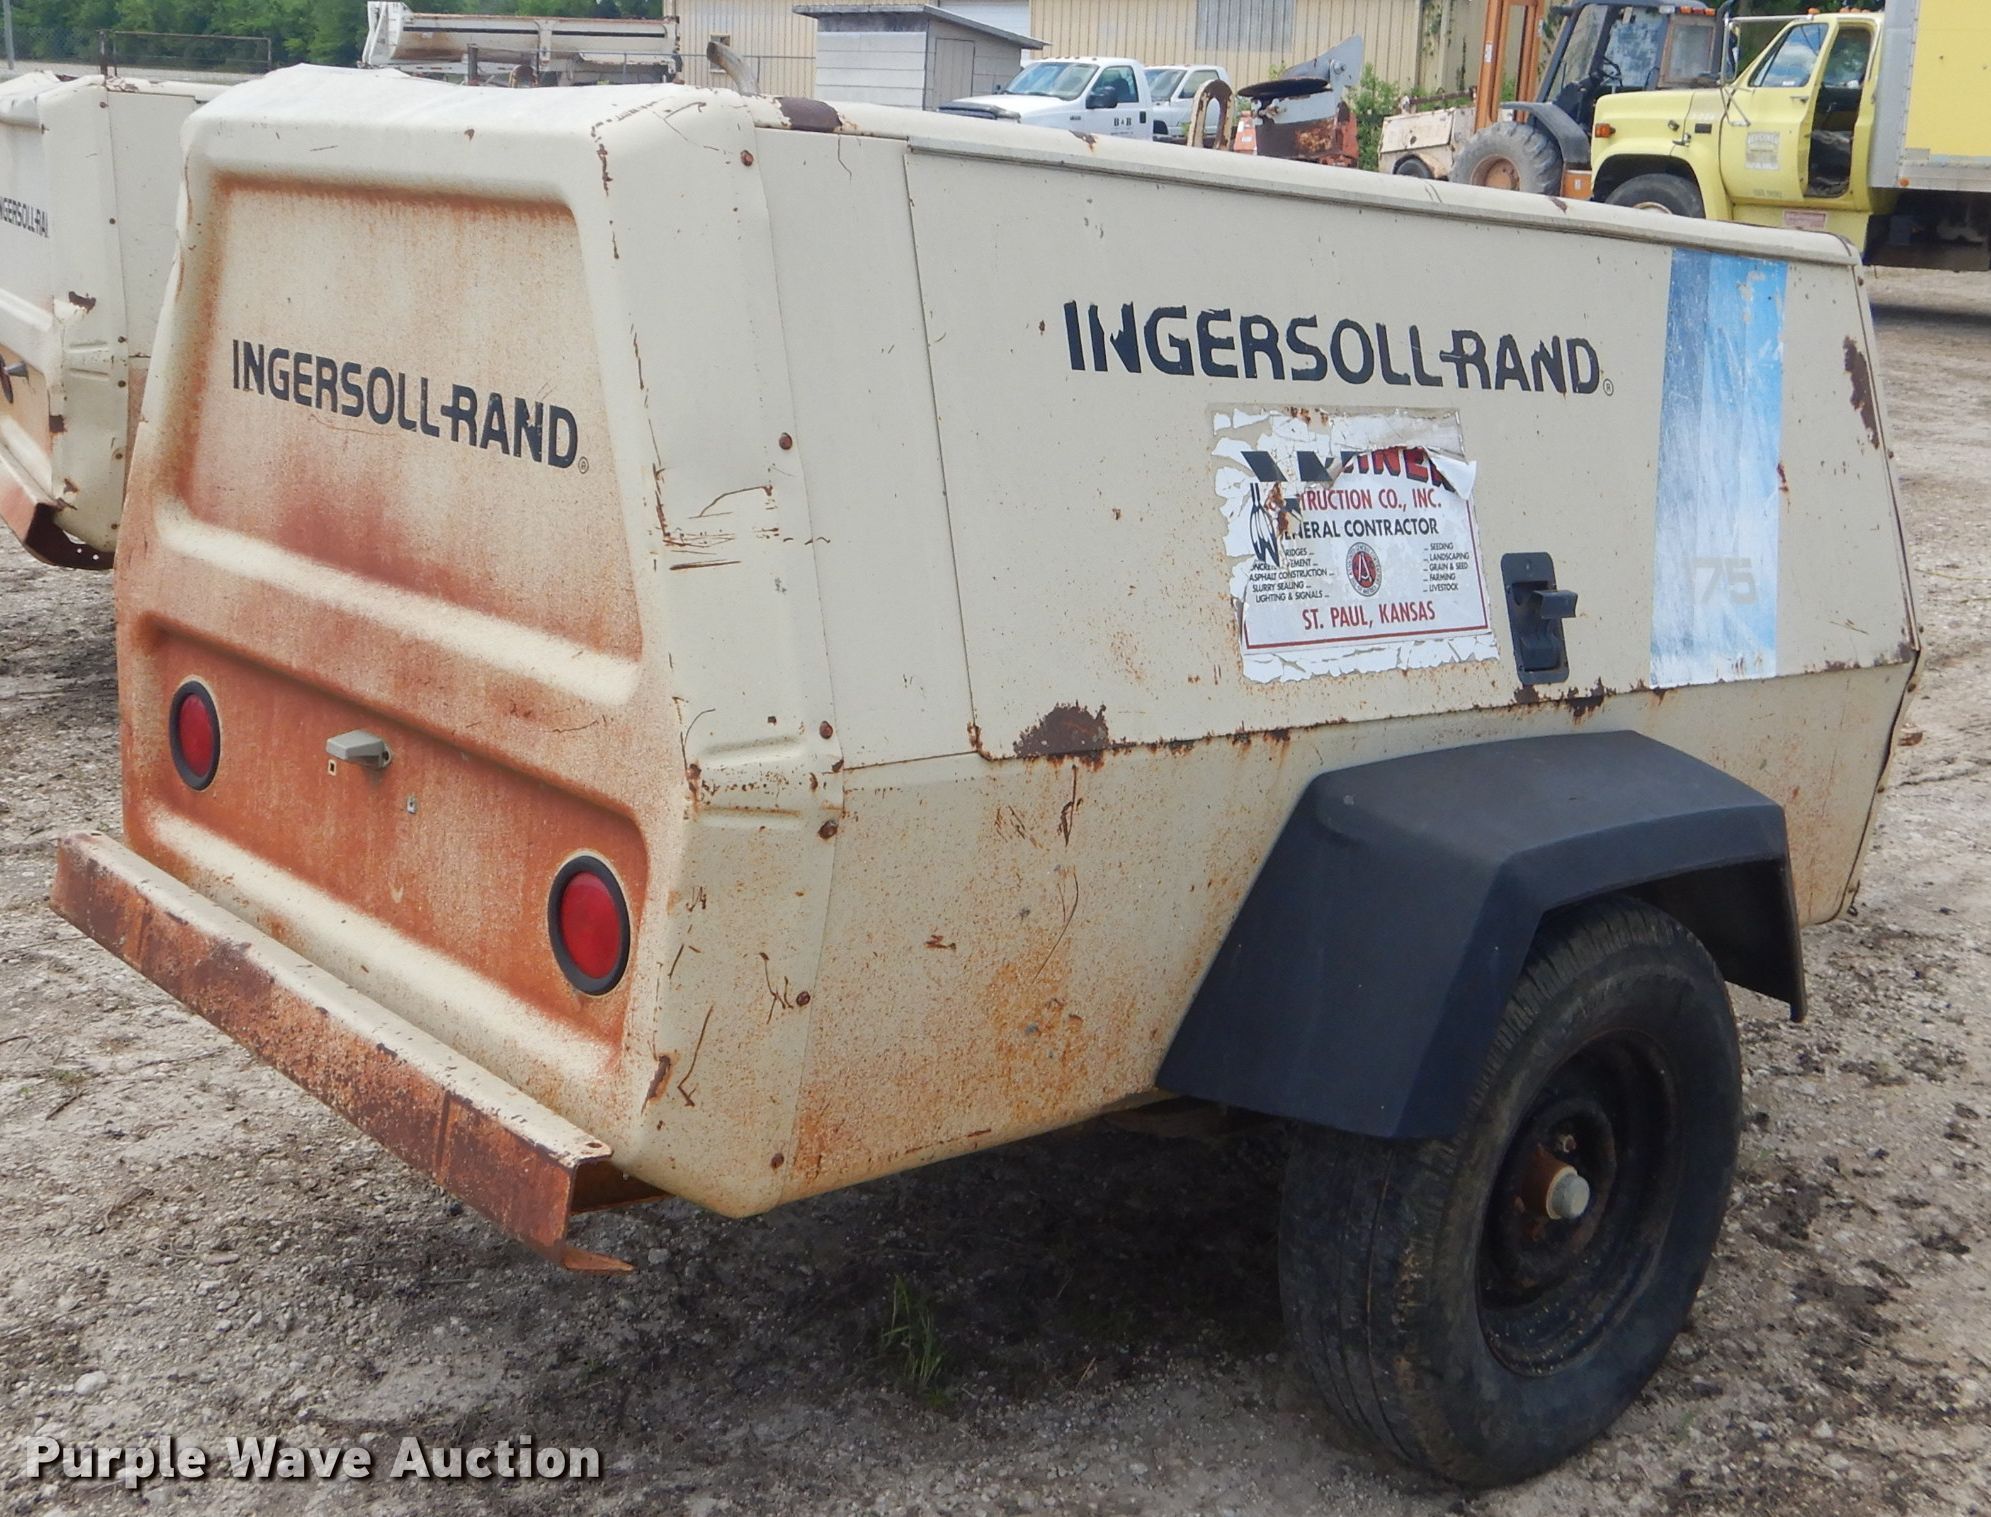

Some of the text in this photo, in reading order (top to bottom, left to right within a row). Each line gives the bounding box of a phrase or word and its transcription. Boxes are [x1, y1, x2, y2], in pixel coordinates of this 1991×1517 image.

[1063, 300, 1600, 395] INGERSOLL-RAND
[232, 339, 579, 469] INGERSOLL-RAND
[1411, 487, 1442, 509] INC.
[1344, 517, 1440, 538] CONTRACTOR
[1430, 542, 1454, 550] SEEDING
[1289, 558, 1311, 567] EMENT
[1429, 552, 1470, 561] LANDSCAPING
[1429, 563, 1449, 571] GRAIN
[1455, 562, 1469, 570] SEED
[1249, 568, 1328, 581] ASPHALT CONSTRUCTION
[1429, 573, 1456, 581] FARMING
[1252, 581, 1304, 593] SLURRY SEALING
[1429, 583, 1459, 592] LIVESTOCK
[1255, 593, 1286, 603] LIGHTING
[1295, 590, 1323, 600] SIGNALS
[1302, 600, 1436, 630] ST. PAUL, KANSAS
